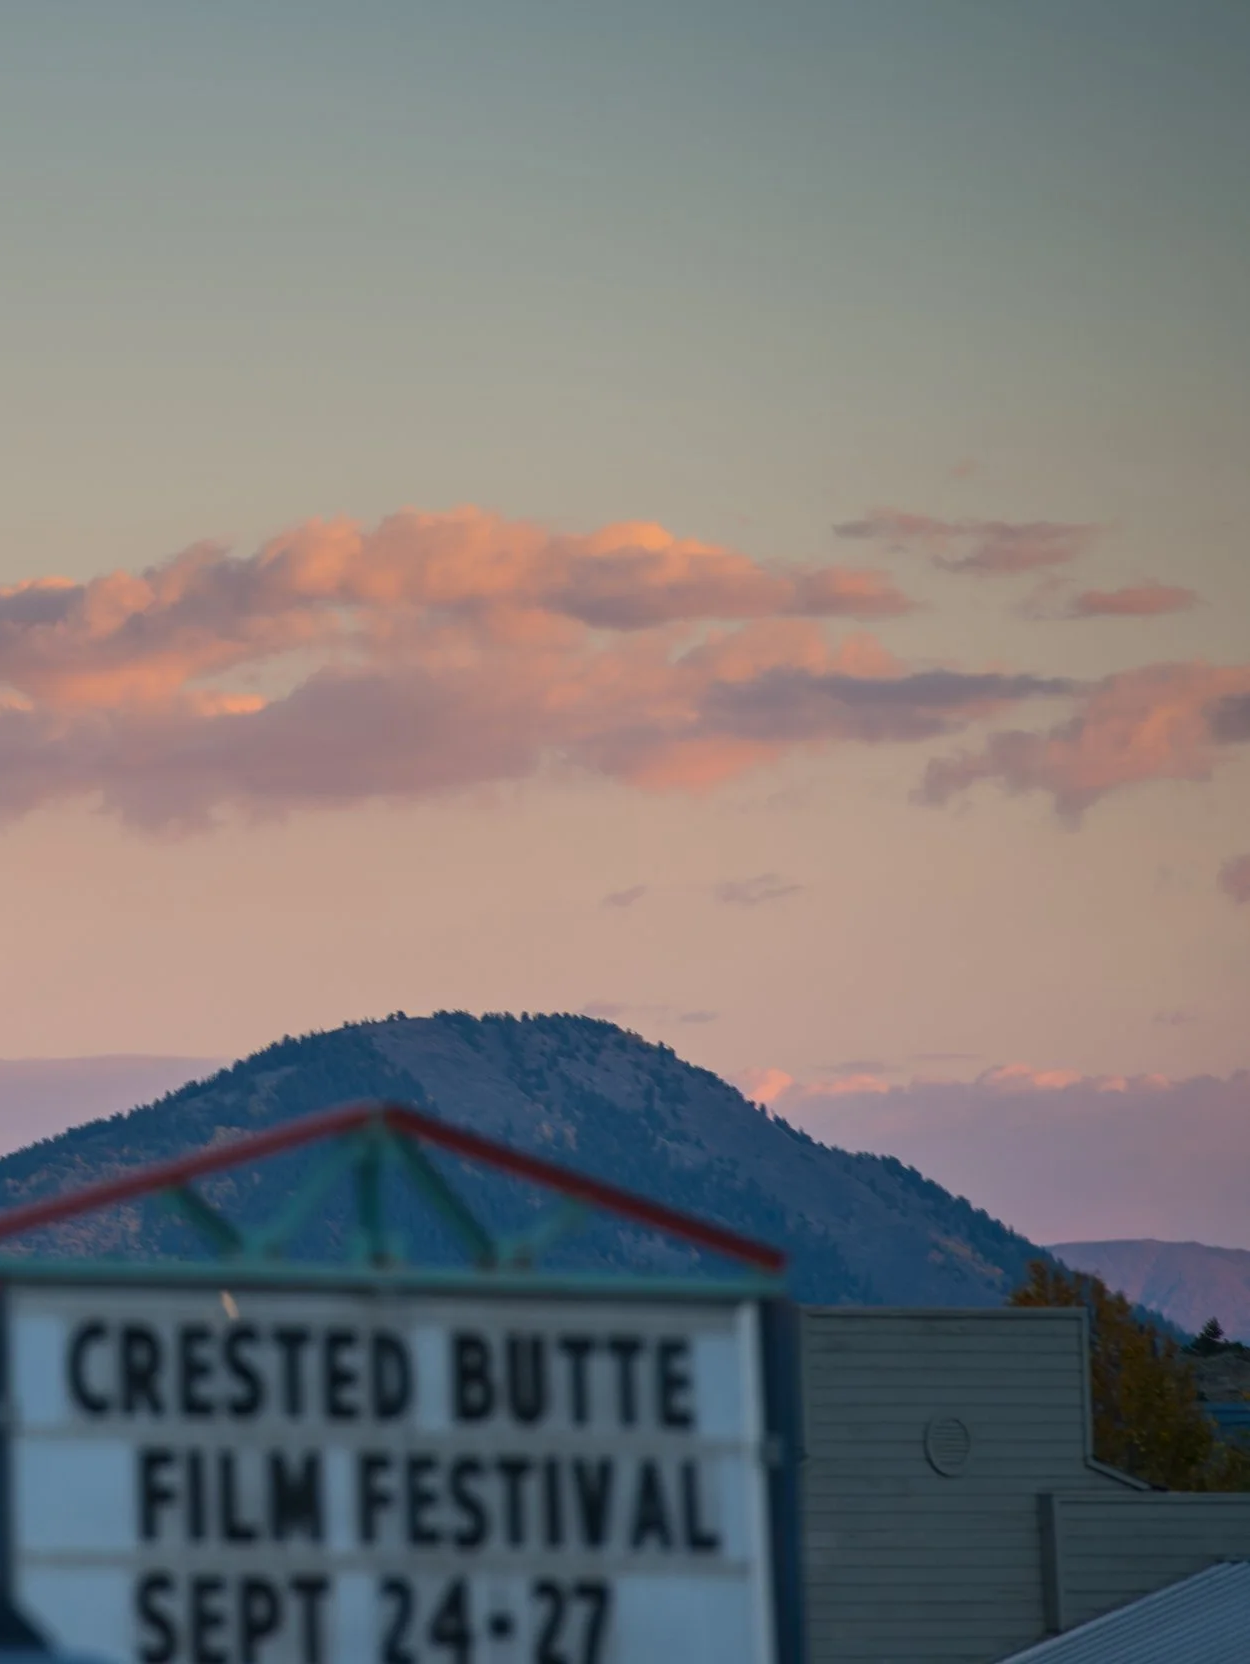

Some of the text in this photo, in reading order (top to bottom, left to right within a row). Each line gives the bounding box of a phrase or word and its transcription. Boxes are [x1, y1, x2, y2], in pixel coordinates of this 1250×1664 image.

[68, 1320, 694, 1430] CRESTED BUTTE
[139, 1445, 722, 1552] FILM FESTIVAL
[137, 1572, 327, 1664] SEPT
